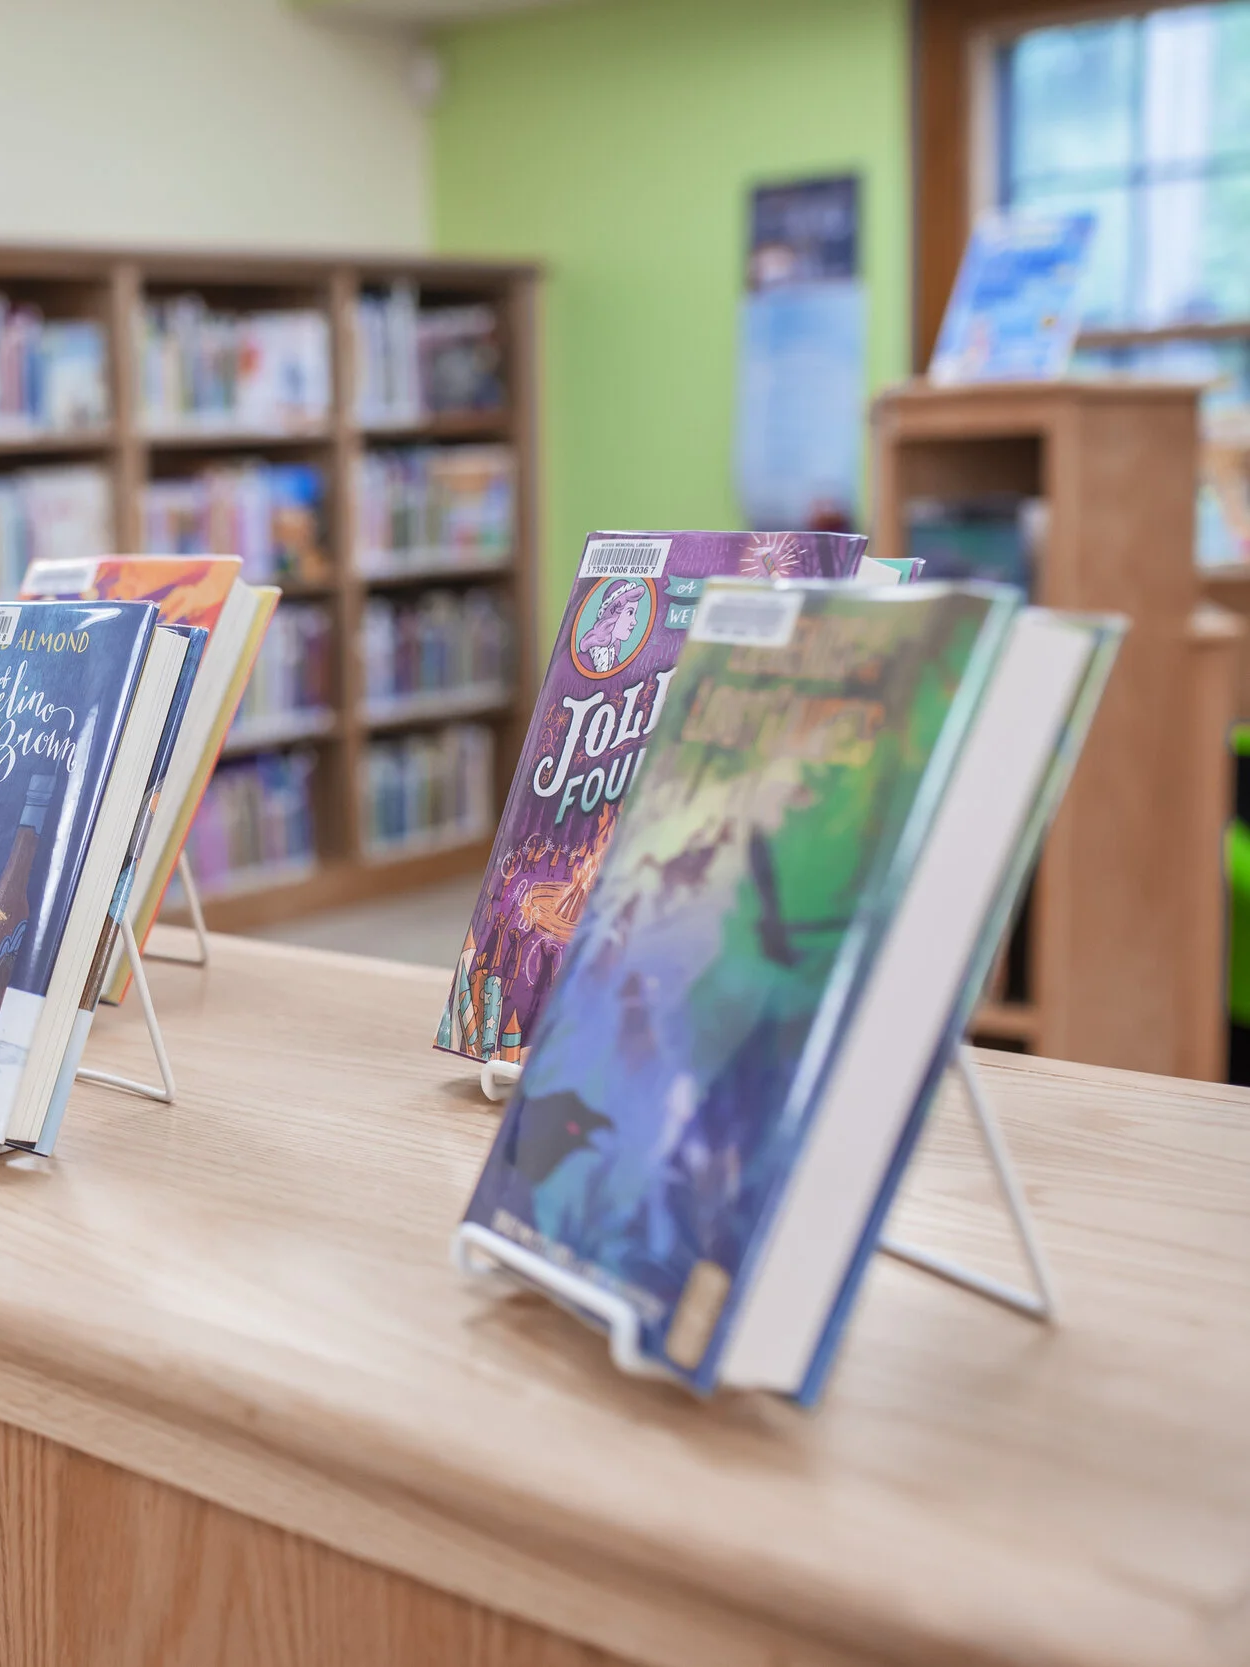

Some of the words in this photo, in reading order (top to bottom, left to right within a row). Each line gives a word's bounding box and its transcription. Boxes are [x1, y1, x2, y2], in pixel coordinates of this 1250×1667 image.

[592, 566, 608, 574] 7389
[610, 566, 628, 574] 0006
[630, 566, 649, 574] 8036
[677, 581, 697, 594] A
[2, 634, 7, 642] 8
[15, 629, 89, 653] ALMOND
